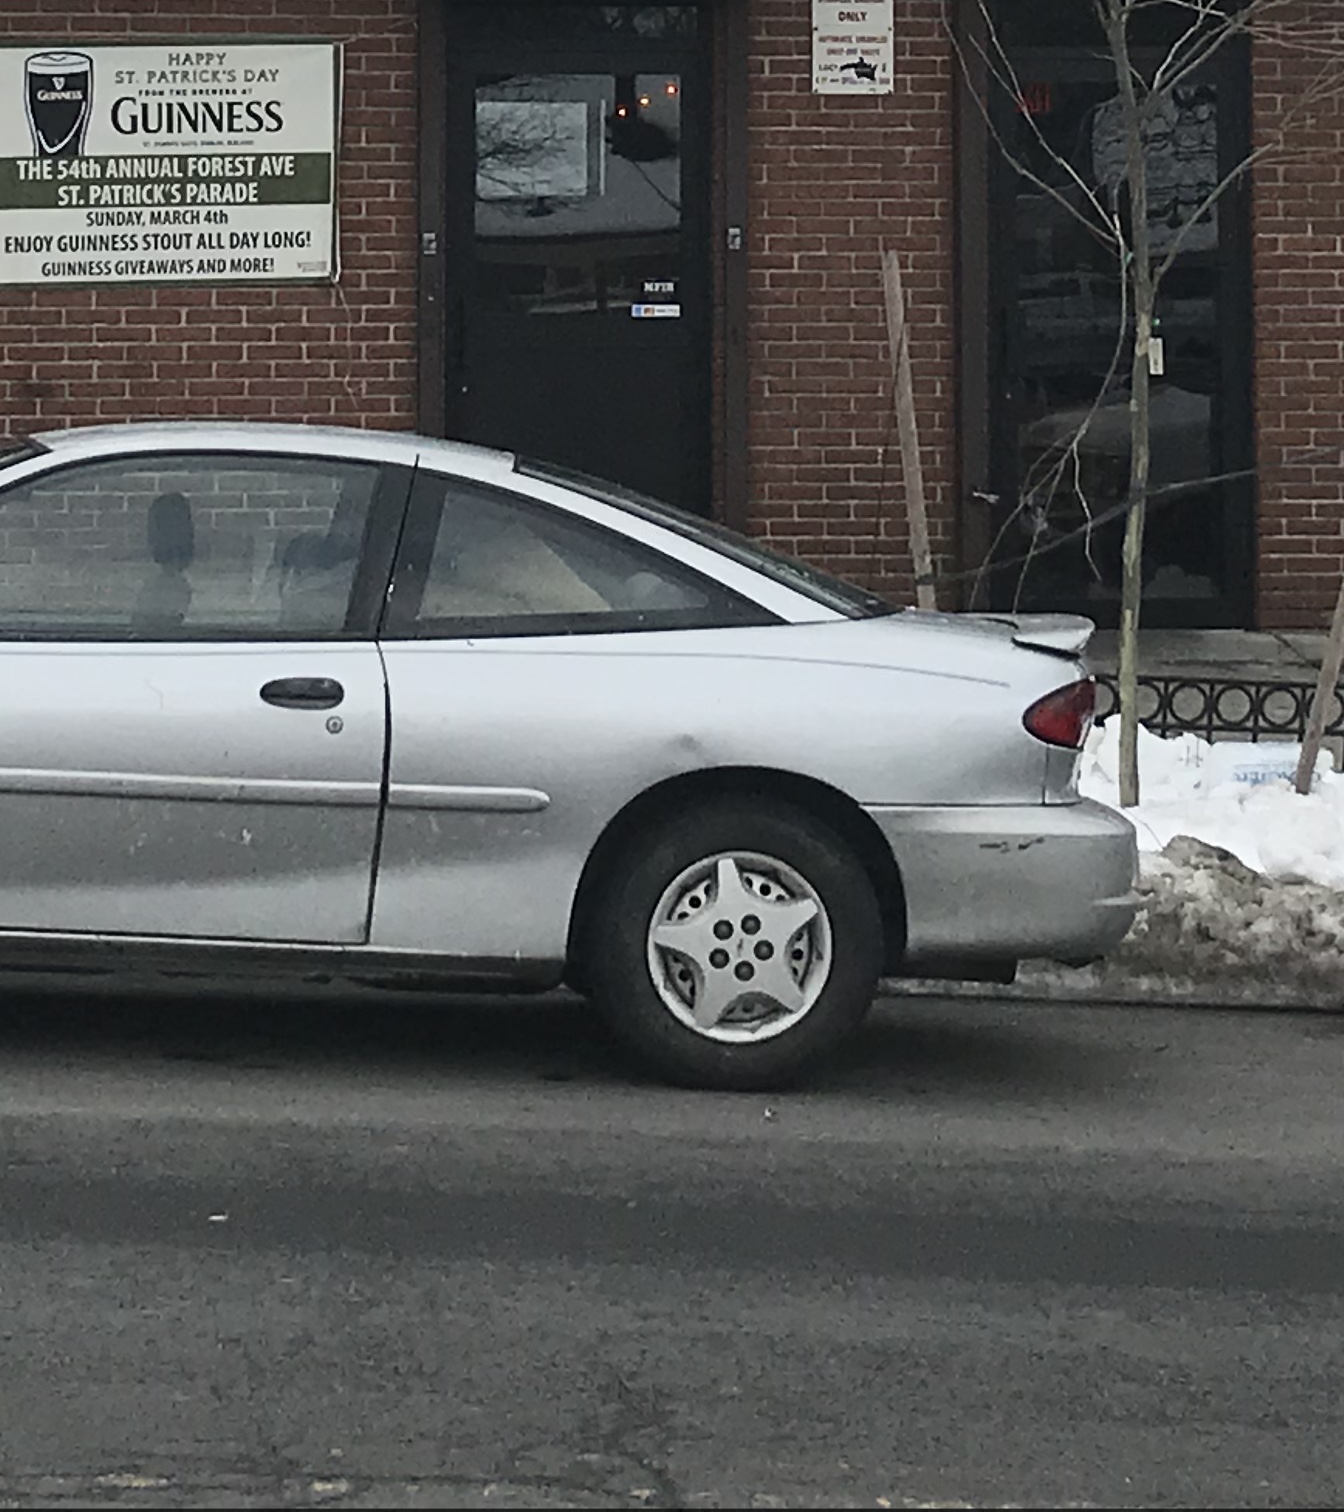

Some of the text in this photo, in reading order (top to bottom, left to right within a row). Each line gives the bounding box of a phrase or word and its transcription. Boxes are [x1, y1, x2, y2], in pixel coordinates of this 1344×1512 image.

[168, 52, 227, 66] HAPPY
[114, 68, 280, 85] ST. PATRICK'S DAY
[36, 90, 83, 101] GUINNESS
[111, 96, 284, 135] GUINNESS
[17, 155, 295, 180] THE 54th ANNUAL FOREST AVE
[57, 182, 258, 206] ST. PATRICK'S PARADE
[86, 209, 229, 227] SUNDAY, MARCH 4th
[4, 231, 311, 254] ENJOY GUINNESS STOUT ALL DAY LONG!
[41, 258, 275, 277] GUINNESS GIVEAWAYS AND MORE!
